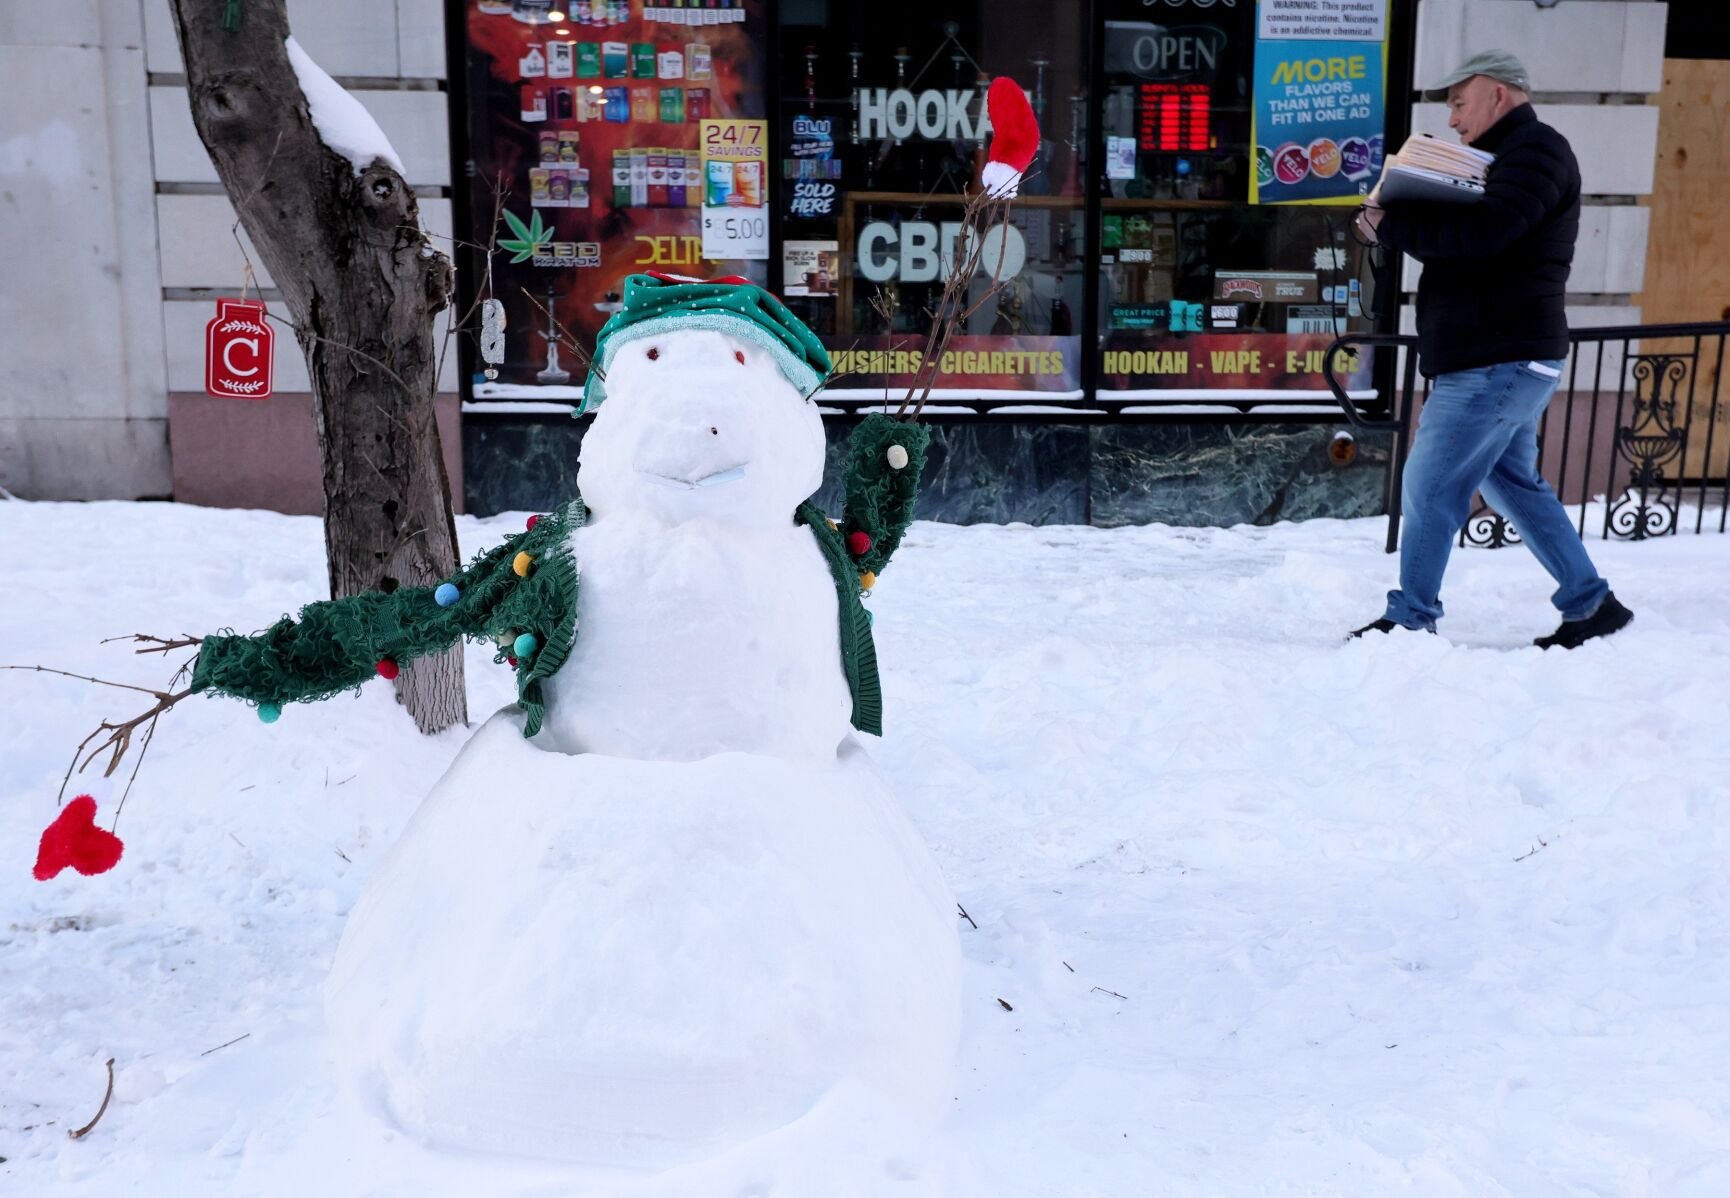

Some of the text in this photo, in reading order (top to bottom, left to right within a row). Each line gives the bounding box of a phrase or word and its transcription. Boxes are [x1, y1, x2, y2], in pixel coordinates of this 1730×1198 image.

[1273, 0, 1374, 12] WARNING: This product
[1266, 14, 1378, 24] contains nicotine. Nicotine
[1270, 26, 1278, 34] is
[1292, 26, 1331, 35] addictive
[1333, 26, 1372, 36] chemical.
[1133, 36, 1217, 71] OPEN
[1271, 55, 1366, 85] MORE
[1285, 81, 1353, 97] FLAVORS
[1268, 93, 1371, 112] THAN WE CAN
[859, 88, 1031, 139] HOOKA
[1271, 107, 1370, 126] FIT IN ONE AD
[706, 125, 762, 145] 24/7
[793, 120, 831, 135] BLU
[706, 146, 762, 156] SAVINGS
[1312, 149, 1337, 166] VELO
[1342, 151, 1368, 164] VELO
[1256, 157, 1273, 178] ELO
[1283, 154, 1304, 177] VELO
[794, 183, 836, 197] SOLD
[790, 198, 835, 214] HERE
[532, 242, 601, 257] CBD
[533, 257, 601, 267] KRATOM
[223, 338, 259, 377] C
[828, 350, 923, 374] WISHERS
[941, 351, 1063, 374] CIGARETTES
[1103, 351, 1188, 374] HOOKAH
[1210, 351, 1261, 374] VAPE
[1286, 349, 1360, 374] E-JUCE
